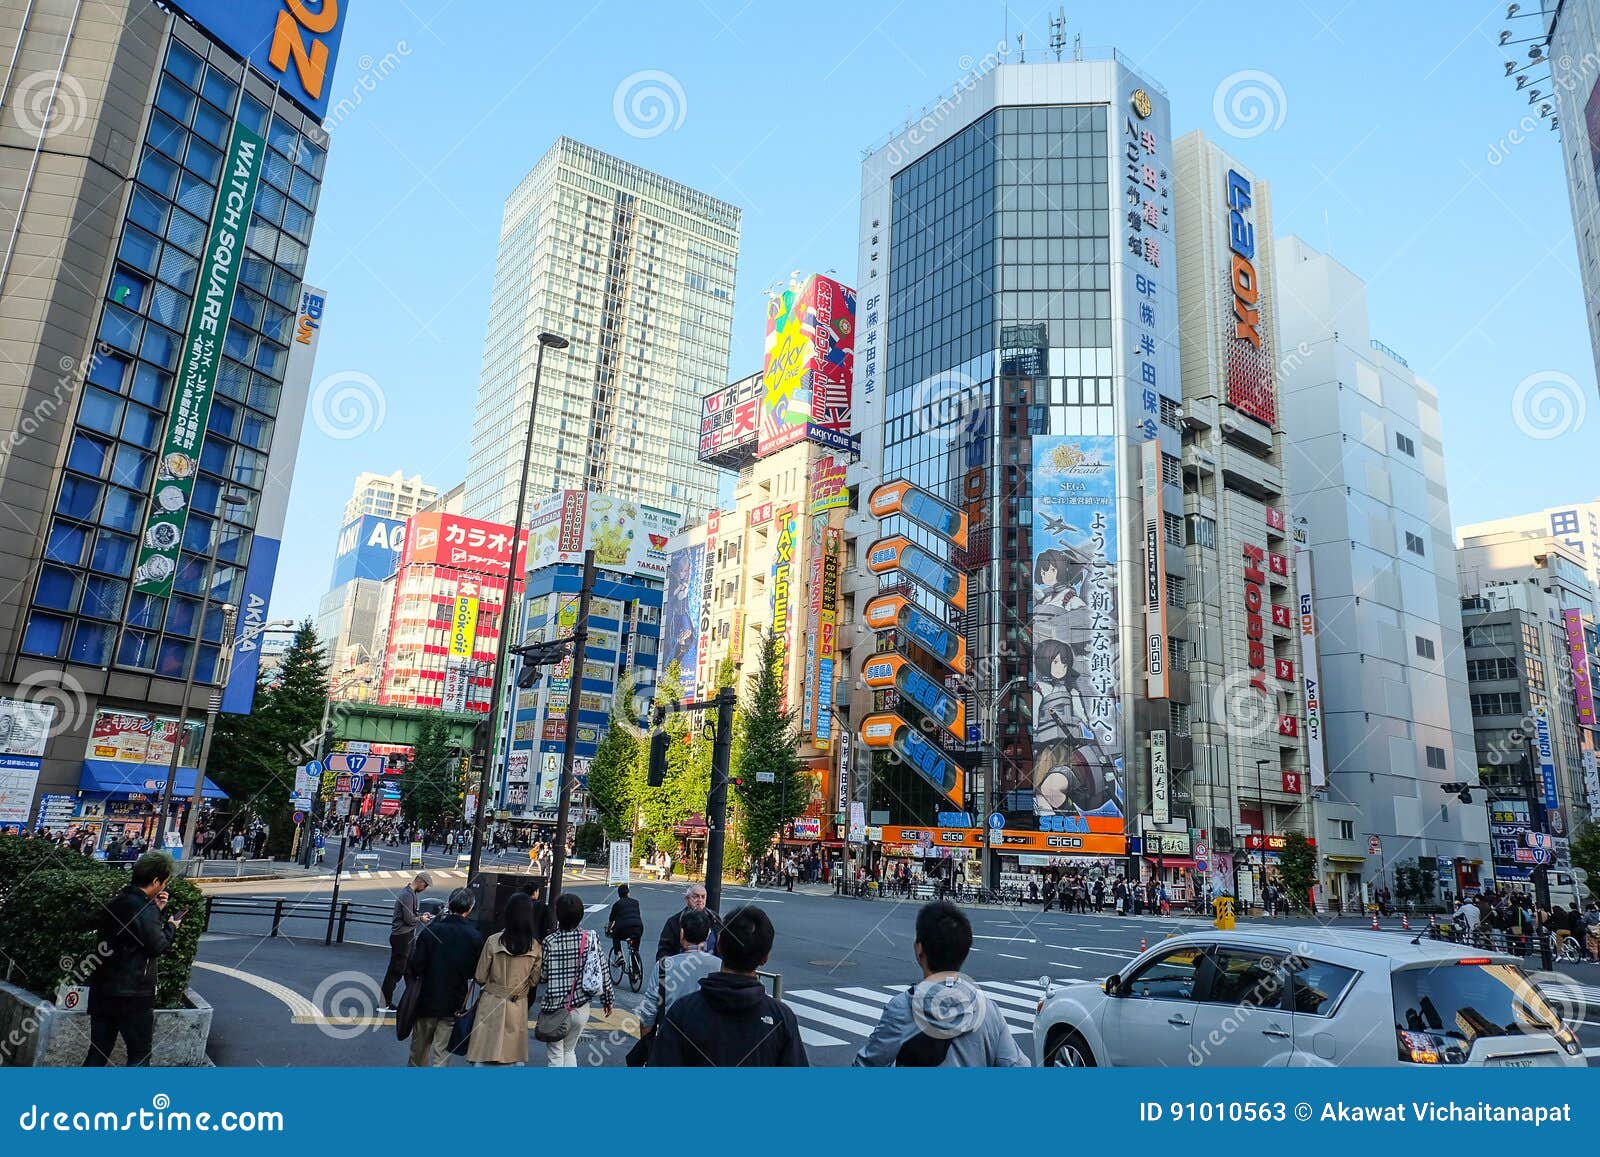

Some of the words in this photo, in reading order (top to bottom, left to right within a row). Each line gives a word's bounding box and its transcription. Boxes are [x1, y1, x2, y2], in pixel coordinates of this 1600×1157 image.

[222, 141, 256, 235] WATCH
[198, 230, 238, 336] SQUARE
[702, 407, 734, 433] 秋葉原
[810, 427, 832, 443] AKKY
[832, 434, 850, 447] ONE
[1060, 482, 1087, 491] SEGA
[560, 495, 574, 551] AKIHABARA
[572, 492, 585, 535] WELCOME
[445, 523, 527, 554] カラオケ
[571, 538, 579, 551] TO
[778, 511, 793, 563] TAX
[871, 547, 897, 565] SEGA
[459, 580, 479, 597] 本
[773, 565, 790, 634] FREE
[239, 593, 265, 653] AKIBA
[1090, 512, 1113, 742] ようこそ新たな鎮守府へ。
[867, 663, 893, 680] SEGA
[903, 670, 948, 721] SEGA
[1536, 718, 1551, 758] ALINCO
[351, 756, 363, 769] 17
[902, 732, 947, 786] SEGA
[351, 776, 359, 791] 17
[1039, 815, 1091, 834] SEGA
[1536, 834, 1543, 846] 17
[1534, 850, 1543, 859] 17
